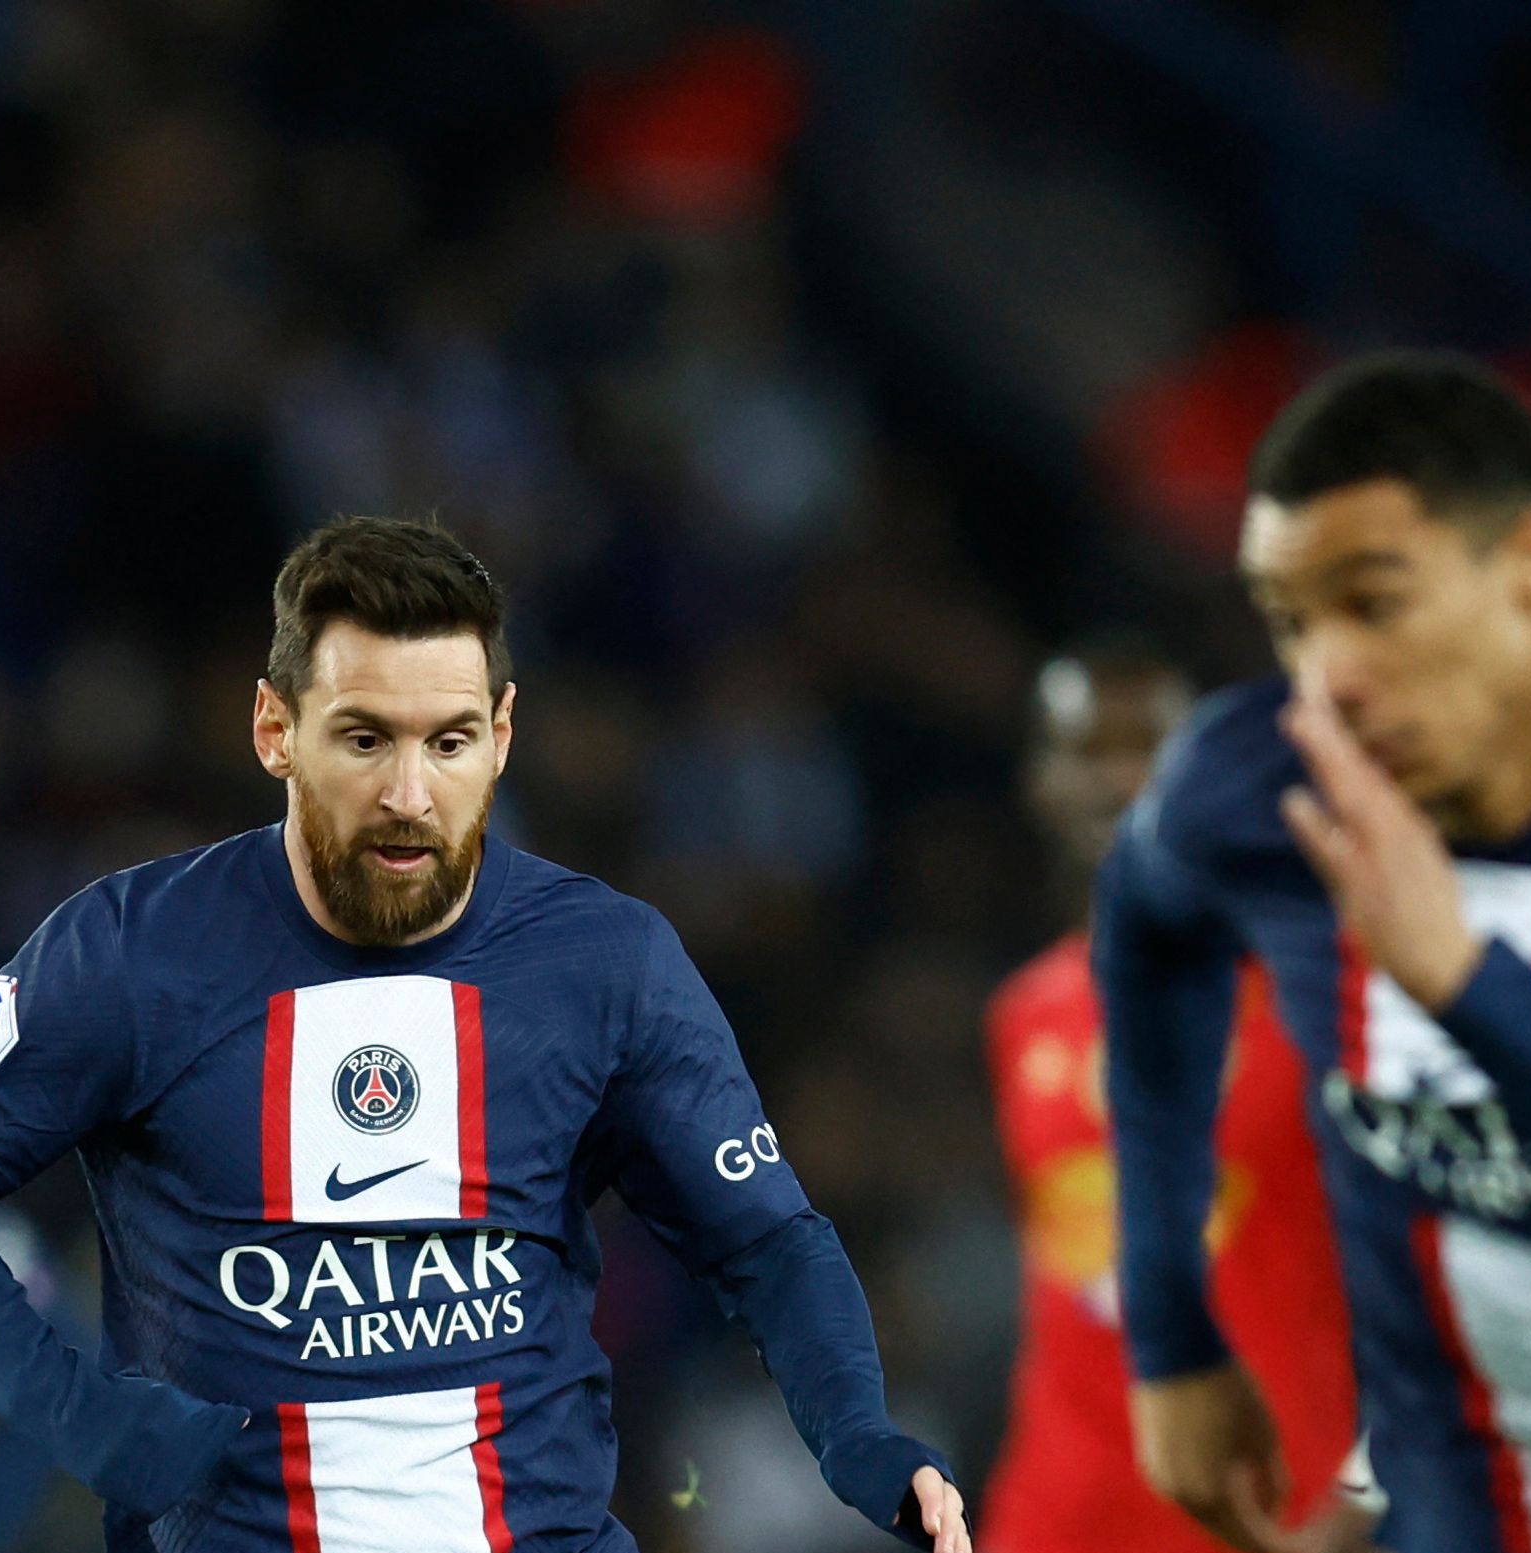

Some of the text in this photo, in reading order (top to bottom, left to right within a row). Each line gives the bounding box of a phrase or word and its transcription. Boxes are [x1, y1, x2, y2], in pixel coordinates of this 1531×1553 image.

[347, 1051, 403, 1073] PARIS
[220, 1227, 522, 1329] QATAR
[300, 1290, 525, 1360] AIRWAYS
